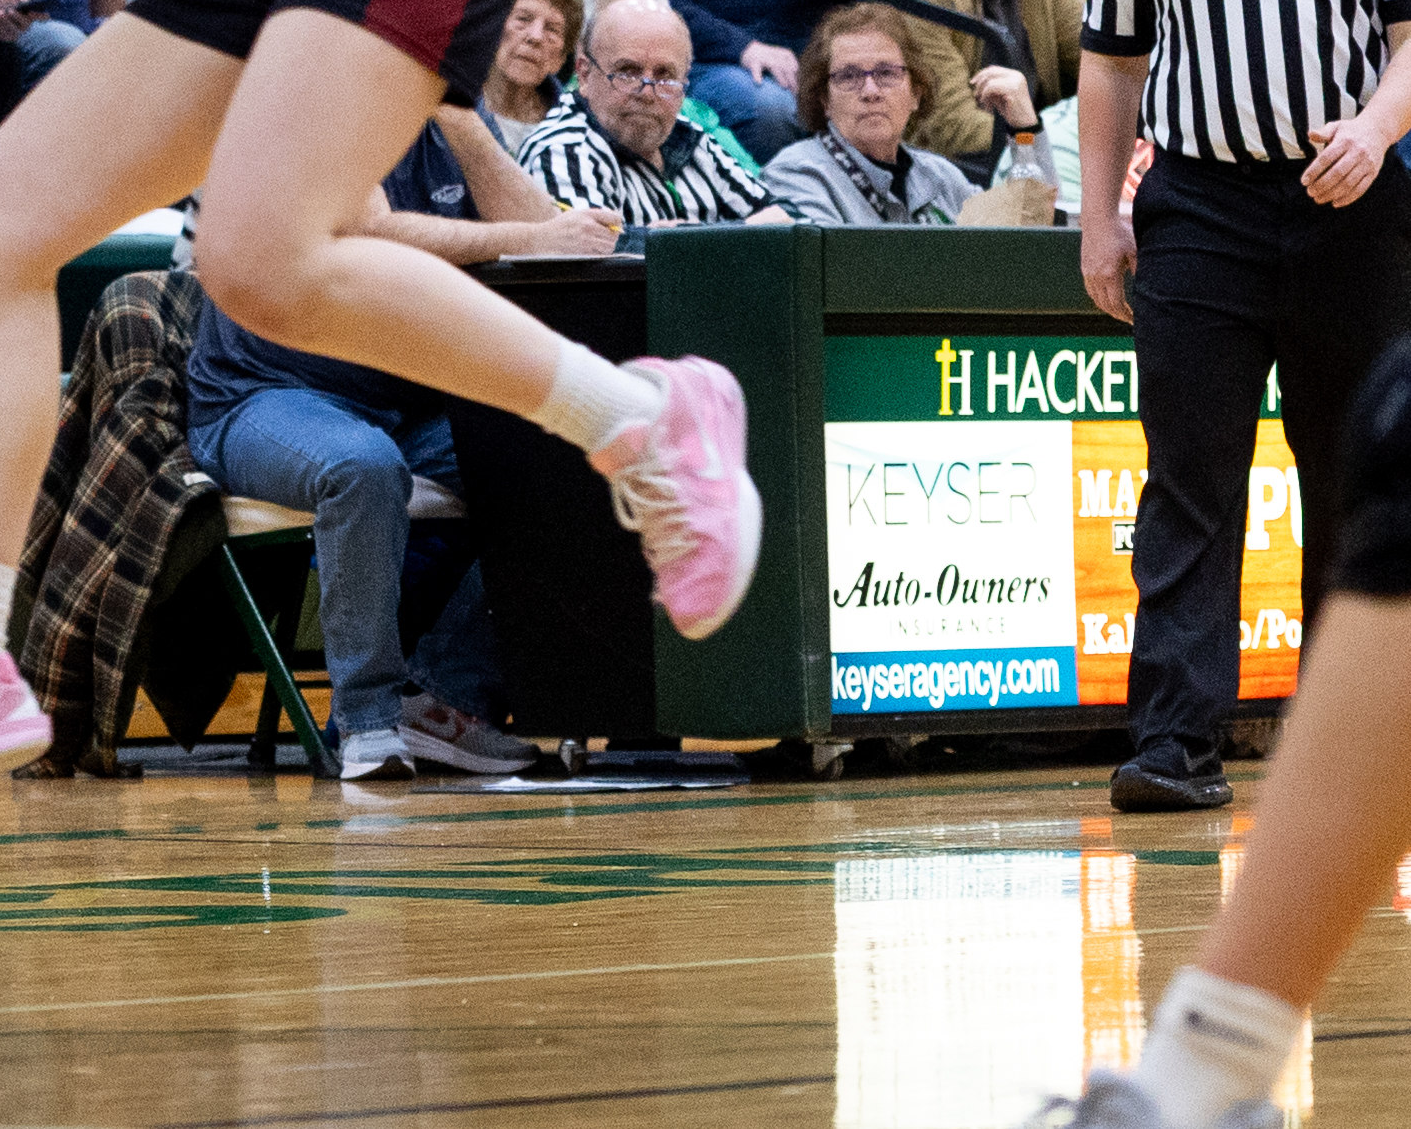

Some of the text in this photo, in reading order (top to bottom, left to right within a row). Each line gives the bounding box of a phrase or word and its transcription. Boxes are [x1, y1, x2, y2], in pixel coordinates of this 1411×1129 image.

[987, 349, 1139, 414] HACKET
[847, 461, 1037, 526] KEYSER
[833, 561, 1052, 609] Auto-Owners
[890, 616, 1006, 637] INSURANCE
[1081, 612, 1136, 655] Kal
[831, 655, 1061, 711] keyseragency.com
